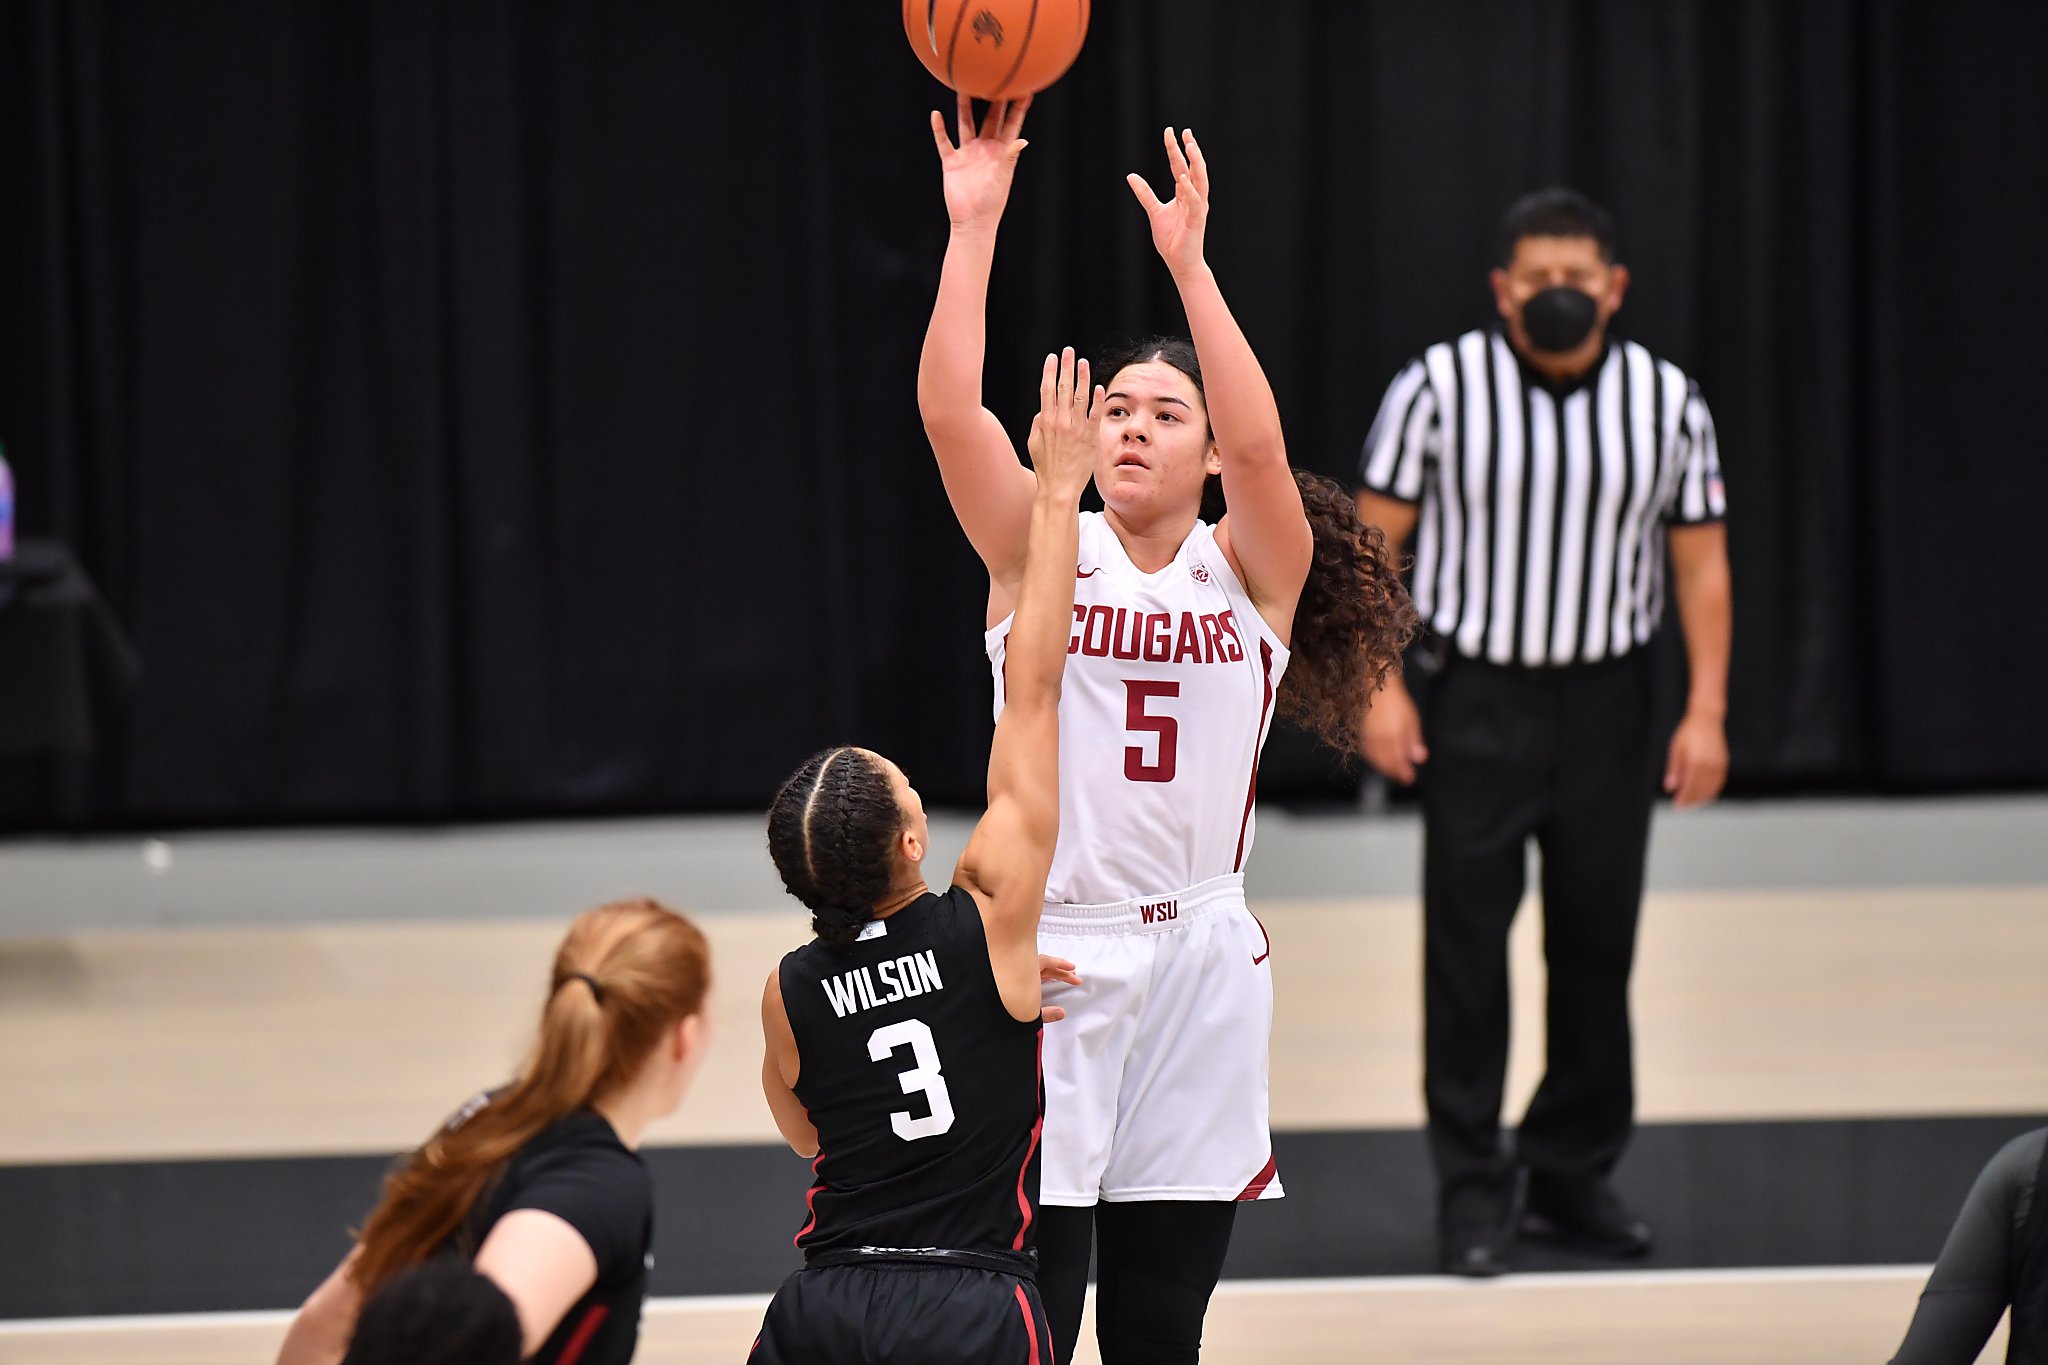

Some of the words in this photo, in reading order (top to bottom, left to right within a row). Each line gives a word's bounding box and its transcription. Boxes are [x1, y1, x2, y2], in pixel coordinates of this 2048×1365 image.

[1120, 679, 1180, 783] 5
[1140, 900, 1178, 925] WSU
[820, 949, 944, 1018] WILSON
[866, 1018, 955, 1141] 3
